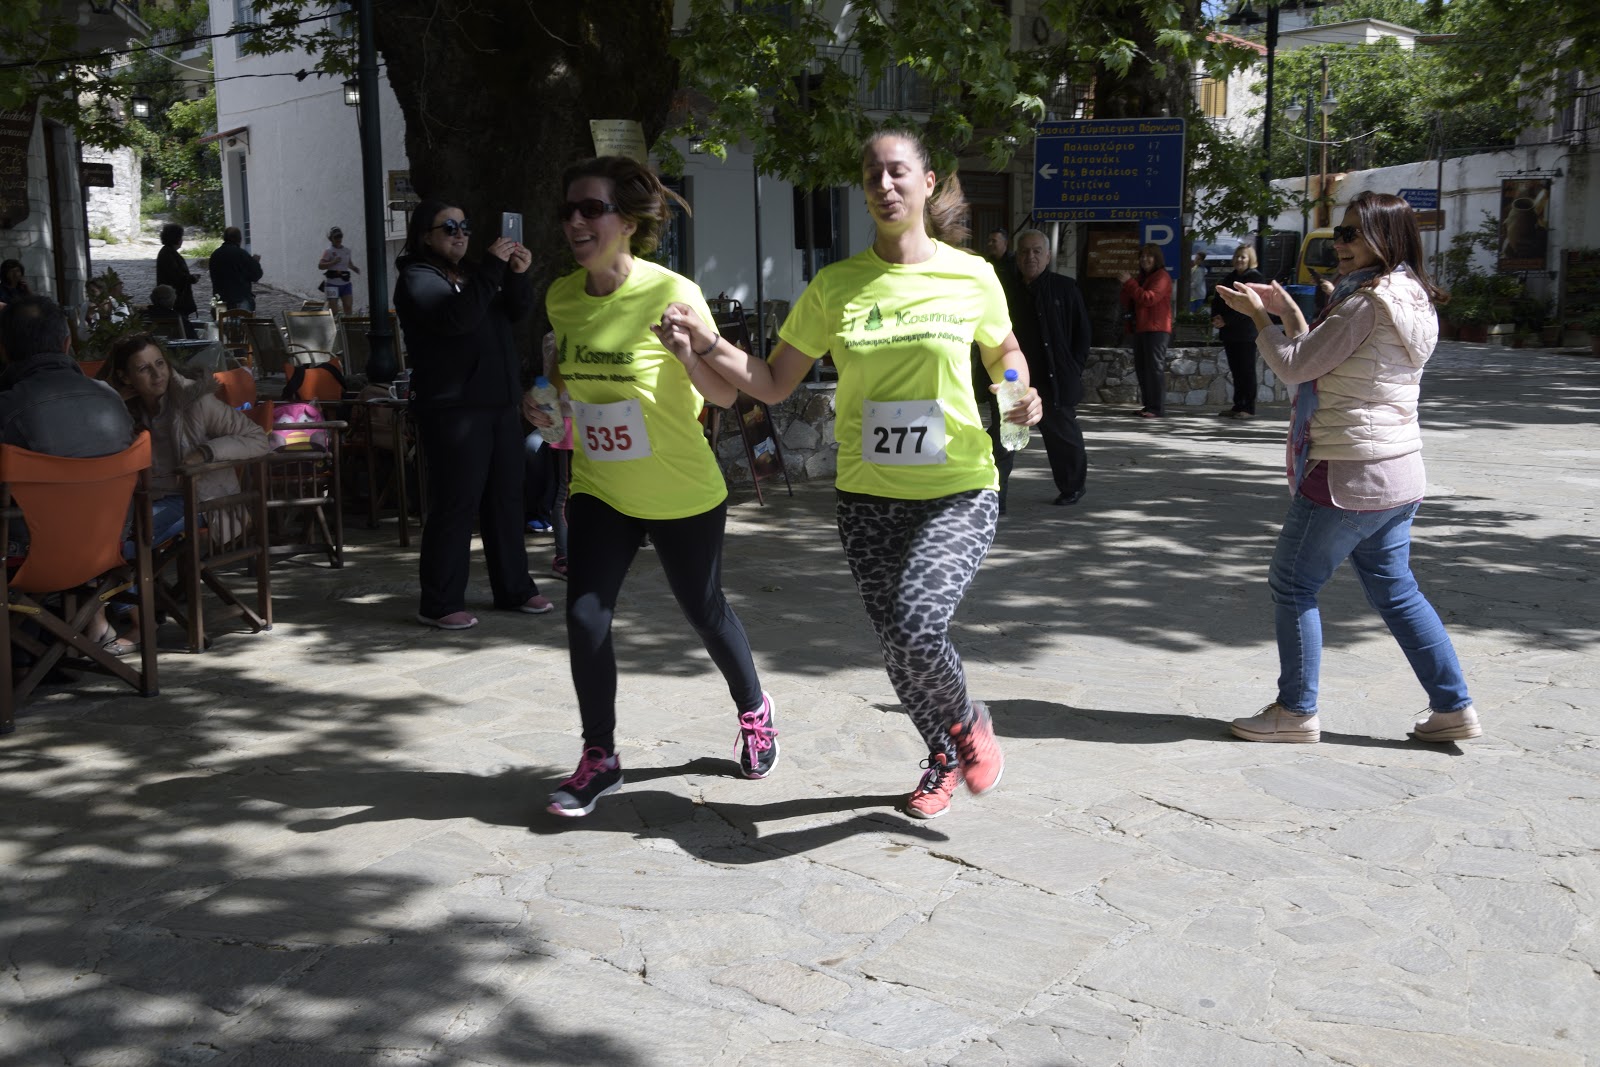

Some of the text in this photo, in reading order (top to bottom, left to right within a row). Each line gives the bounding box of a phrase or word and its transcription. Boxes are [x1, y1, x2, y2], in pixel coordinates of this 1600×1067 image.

[1040, 124, 1075, 135] Δασικό
[1080, 123, 1135, 135] Σύμπλεγμα
[1063, 141, 1161, 152] Παλαιοχώριο 17
[1063, 154, 1160, 164] Πλατανάκι 21
[1081, 167, 1139, 177] Βασίλειος
[1061, 191, 1120, 203] Βαμβακού
[1037, 208, 1159, 220] Δασαρχείο Σπάρτης
[1145, 224, 1174, 247] P
[575, 345, 634, 364] Kosmas
[585, 425, 633, 452] 535
[873, 426, 928, 454] 277
